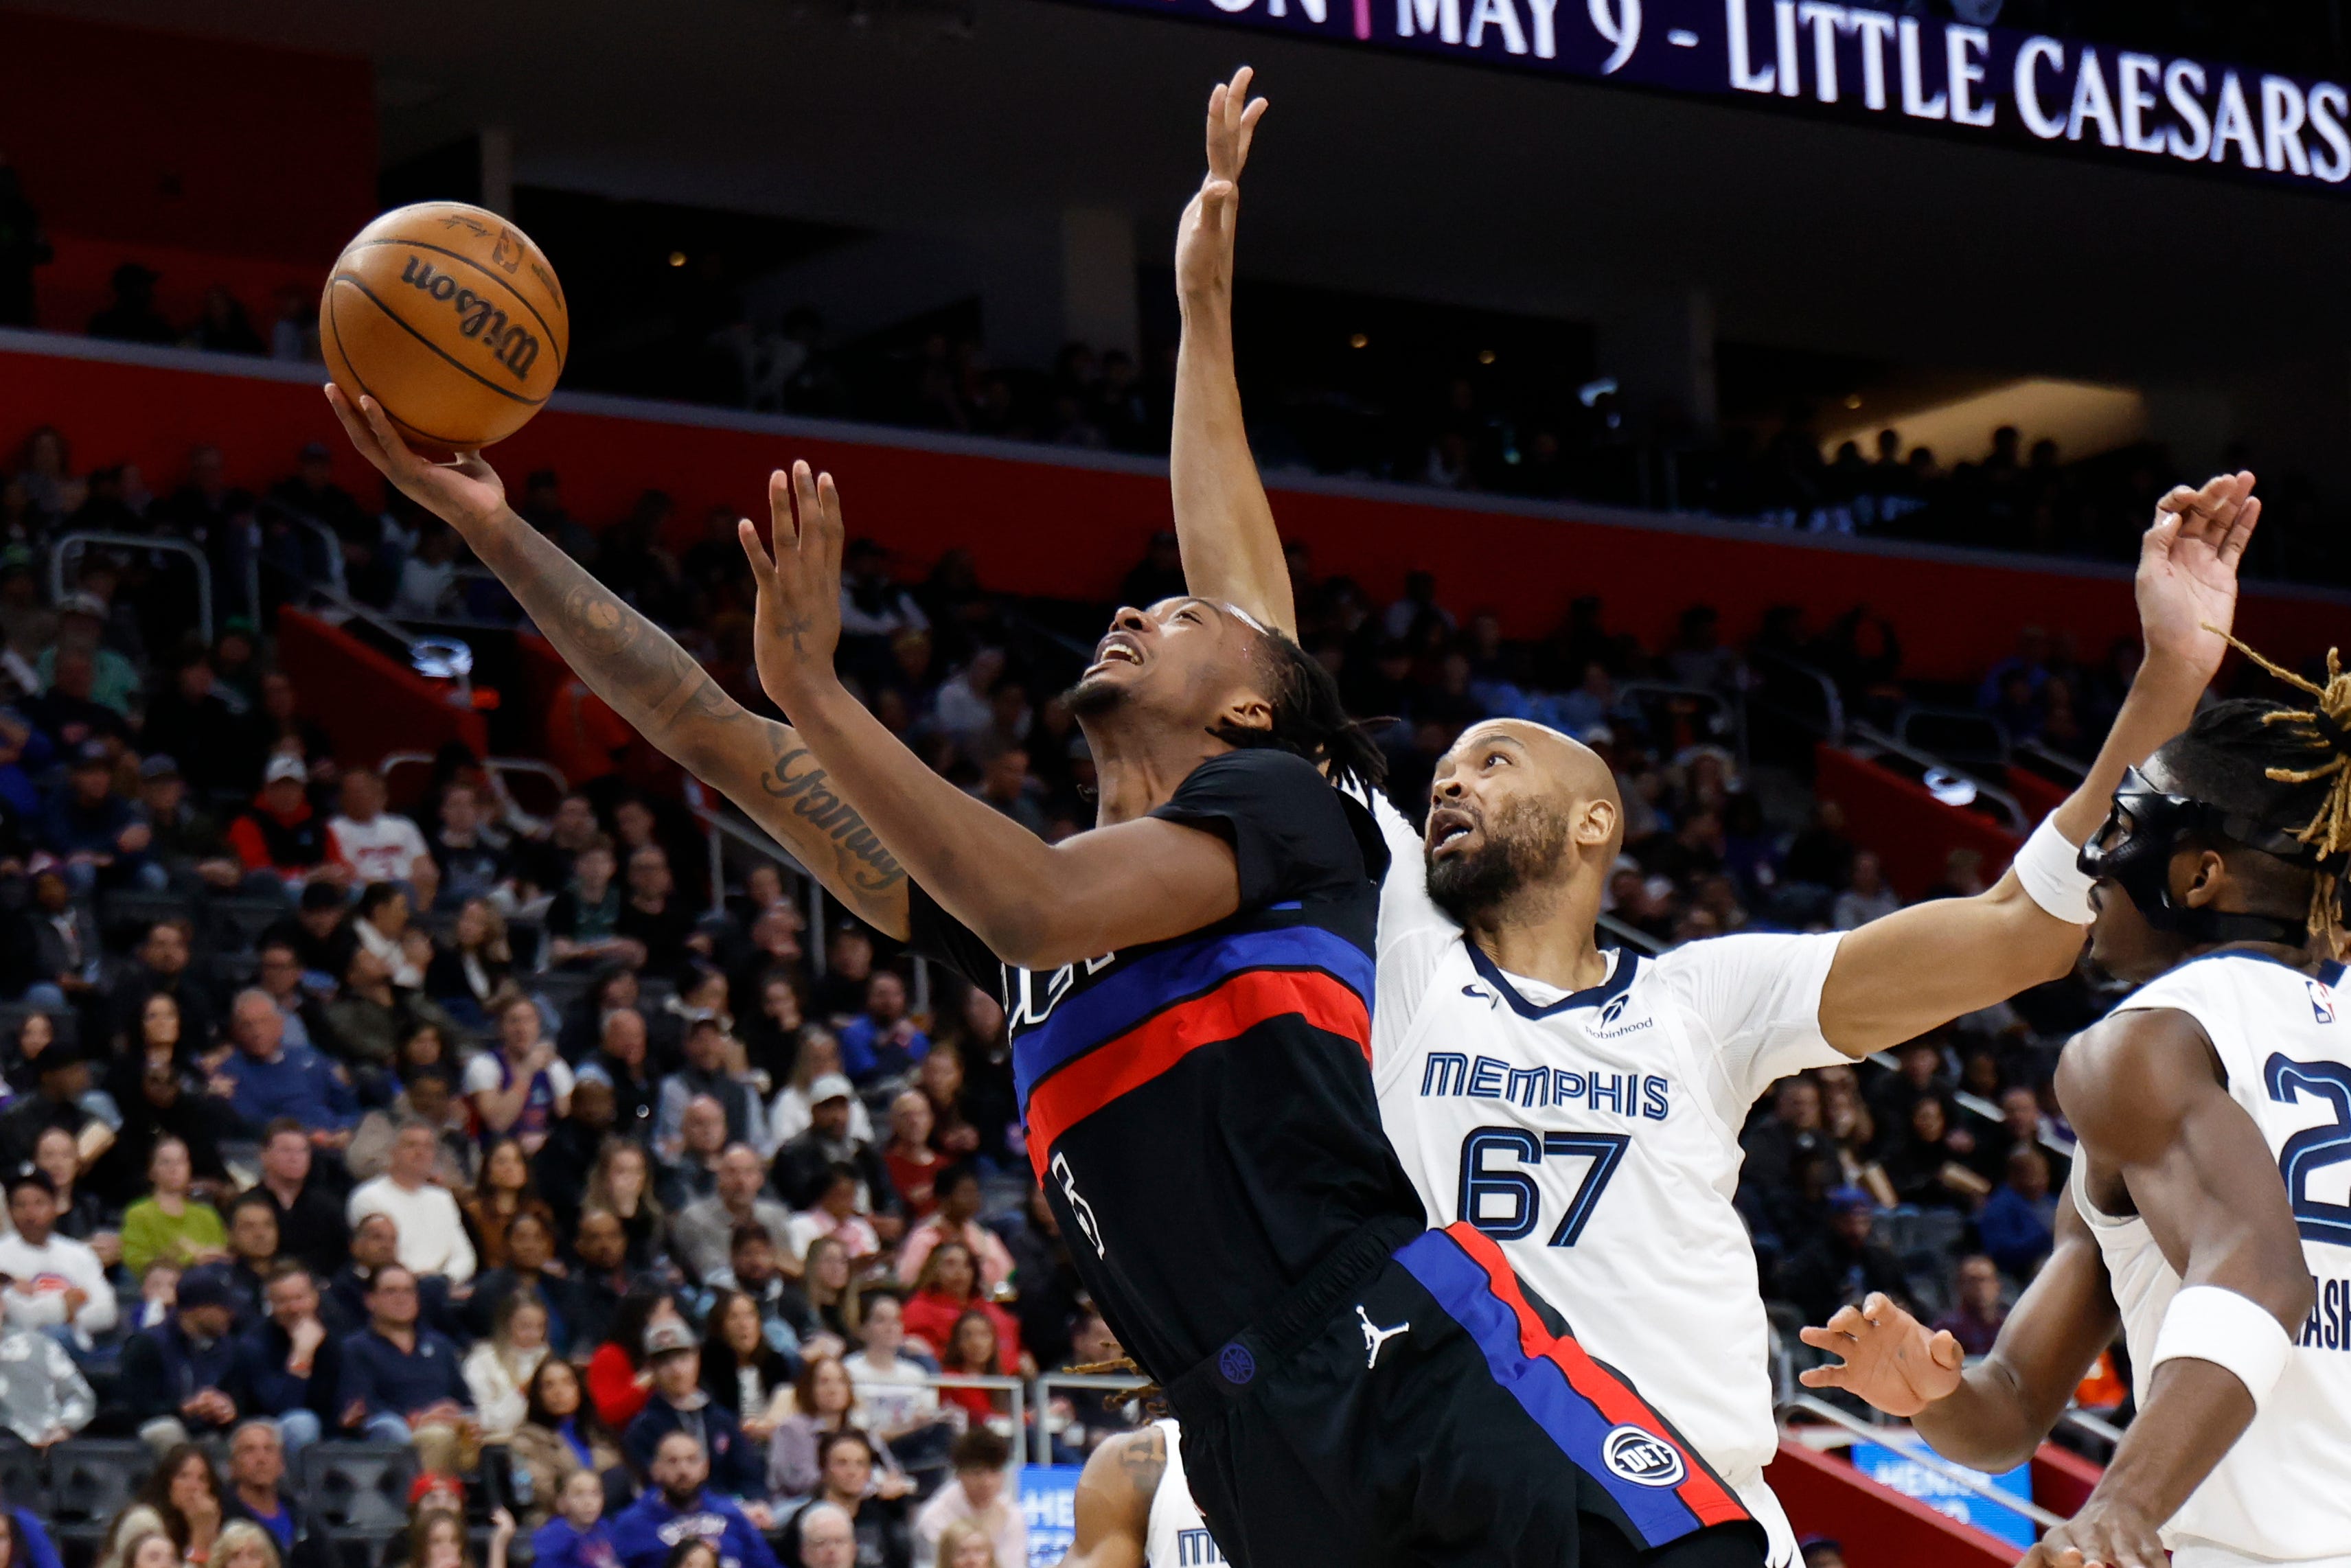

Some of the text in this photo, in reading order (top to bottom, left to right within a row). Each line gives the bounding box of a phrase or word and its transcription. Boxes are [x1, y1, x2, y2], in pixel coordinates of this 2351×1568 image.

[1725, 0, 1996, 128] LITTLE
[2013, 34, 2351, 183] CAESARS
[400, 254, 540, 382] Wilson
[1420, 1051, 1669, 1122] MEMPHIS
[2263, 1051, 2351, 1247] 2
[1456, 1125, 1632, 1248] 67
[1616, 1443, 1670, 1473] DET
